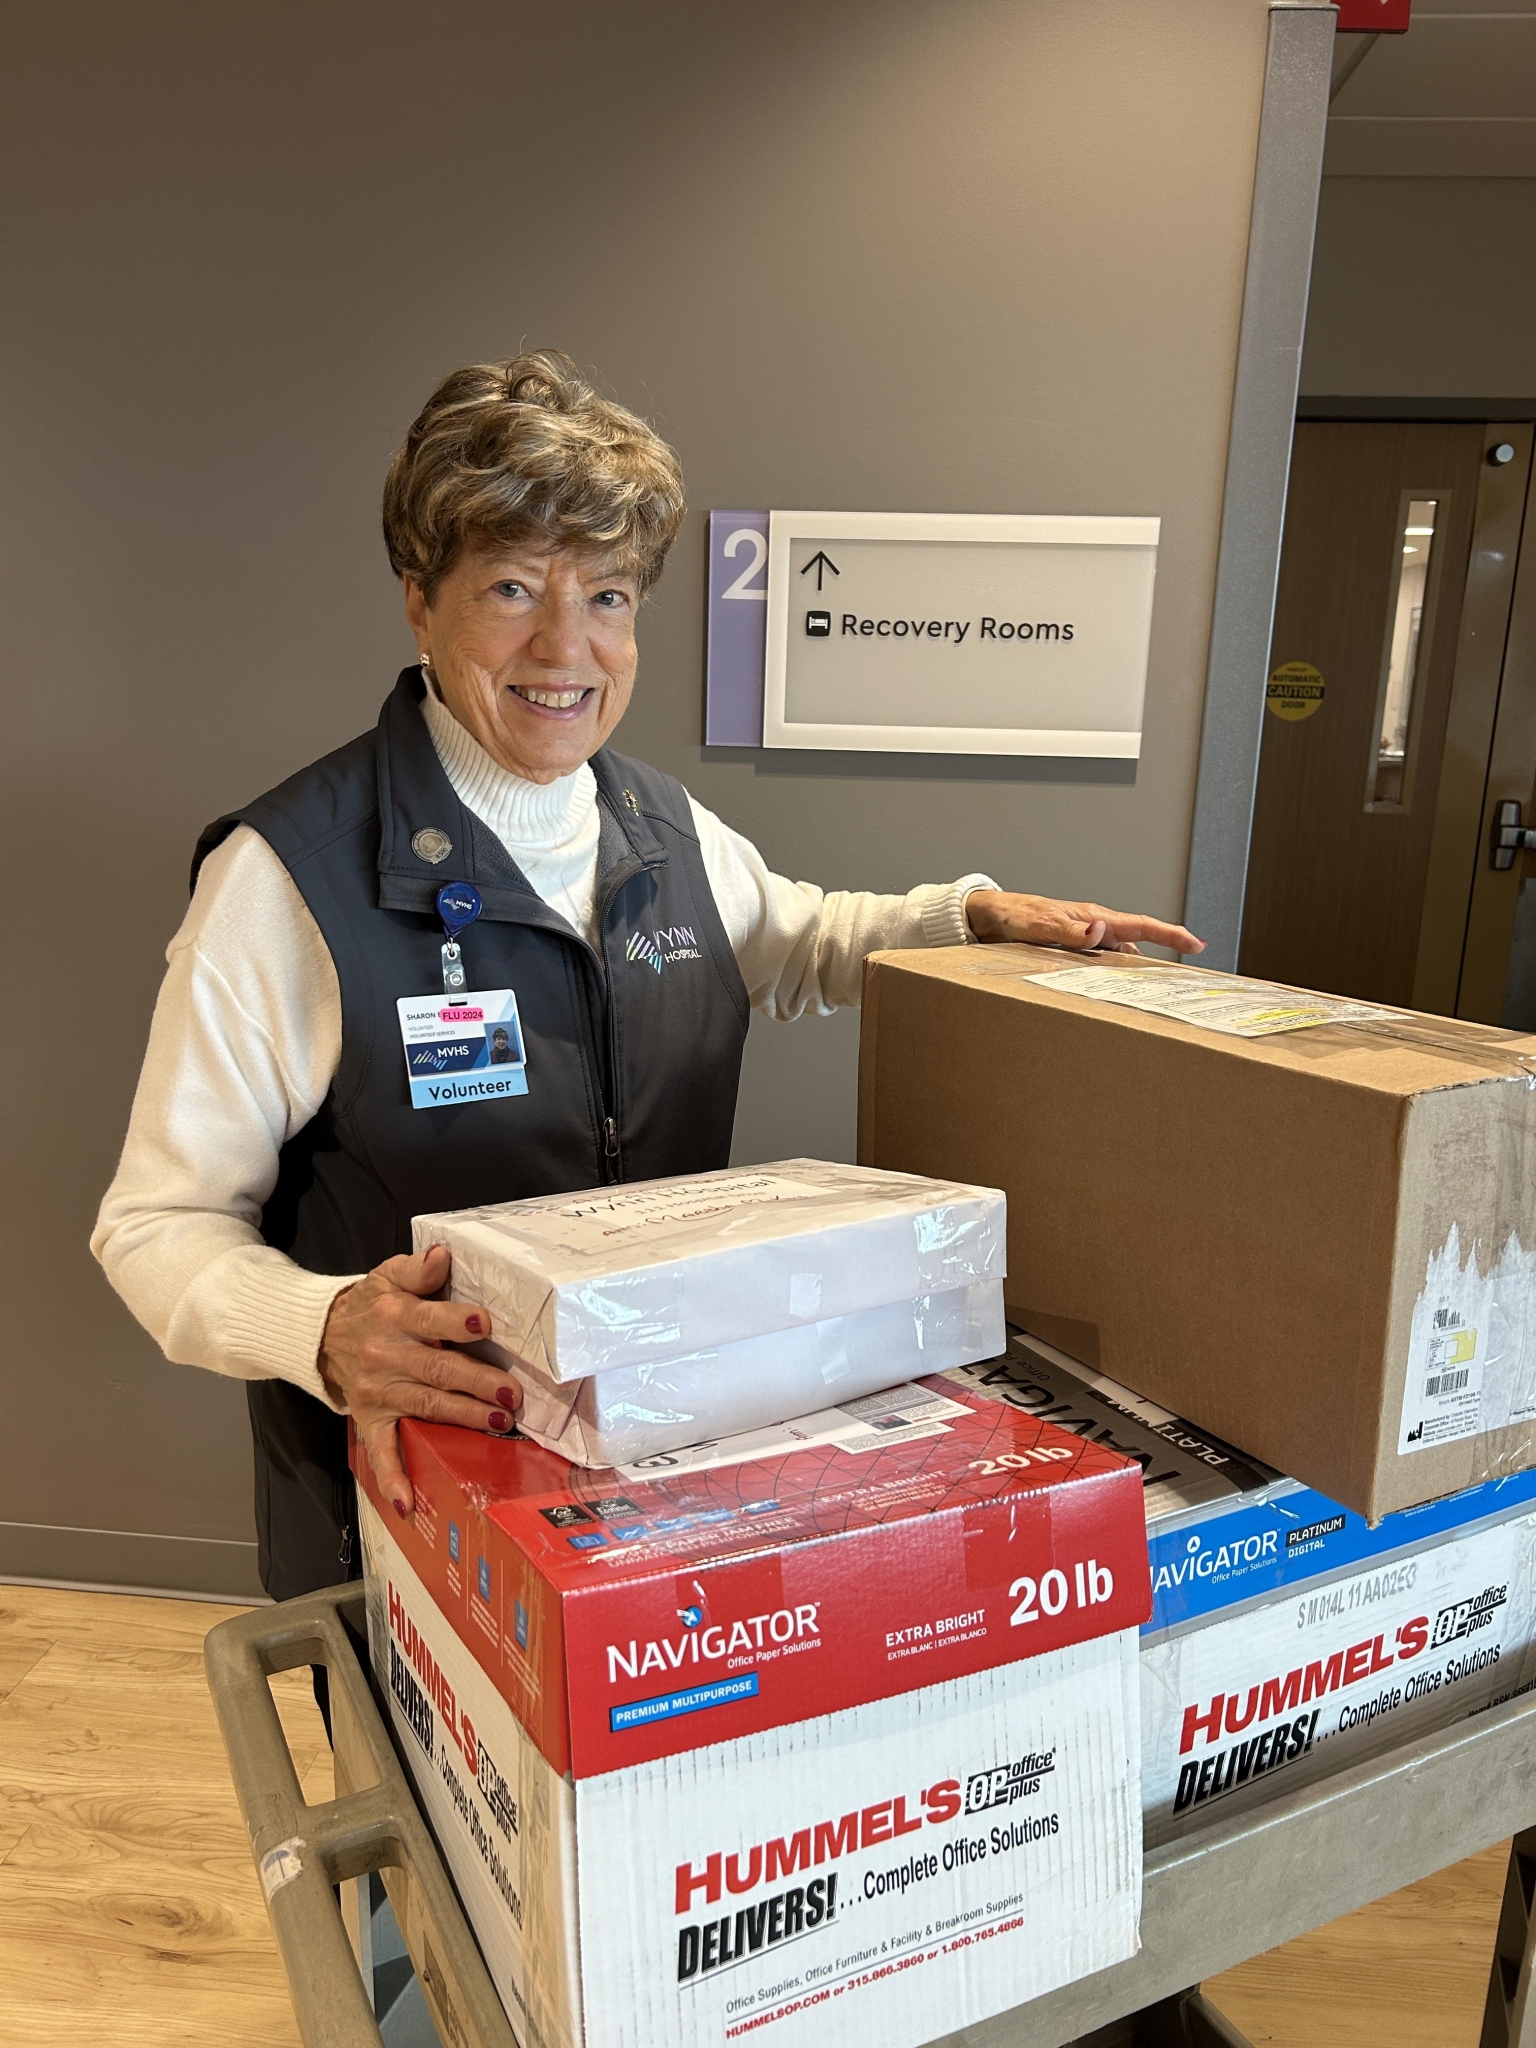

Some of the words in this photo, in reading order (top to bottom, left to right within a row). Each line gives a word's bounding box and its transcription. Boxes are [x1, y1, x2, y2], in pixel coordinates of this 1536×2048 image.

[721, 528, 768, 600] 2
[842, 614, 970, 643] Recovery
[980, 616, 1075, 641] Rooms
[1267, 685, 1320, 698] CAUTION
[406, 1012, 436, 1021] SHARON
[408, 1024, 434, 1032] VOLUNTEER
[442, 1011, 461, 1020] FLU
[462, 1010, 484, 1020] 2024
[409, 1031, 436, 1039] VOLUNTEER
[437, 1045, 470, 1058] MVHS
[428, 1080, 512, 1101] Volunteer
[657, 1178, 777, 1199] Hospital
[1017, 1359, 1050, 1381] Office
[821, 1483, 883, 1504] EXTRA
[883, 1469, 947, 1490] BRIGHT
[702, 1521, 805, 1547] PERFORMANCE
[721, 1526, 756, 1537] JAM
[756, 1516, 795, 1529] FREE
[1288, 1516, 1343, 1545] PLATINUM
[1288, 1539, 1326, 1559] DIGITAL
[1211, 1571, 1230, 1584] Office
[1231, 1565, 1249, 1579] Paper
[1249, 1556, 1278, 1572] Solutions
[1473, 1584, 1508, 1610] office
[885, 1623, 933, 1648] EXTRA
[936, 1609, 985, 1634] BRIGHT
[1466, 1611, 1494, 1638] plus
[606, 1603, 821, 1684] NAVIGATOR
[727, 1654, 754, 1670] Office
[756, 1648, 781, 1663] Paper
[782, 1637, 822, 1656] Solutions
[887, 1647, 911, 1661] EXTRA
[911, 1641, 934, 1656] BLANC
[938, 1635, 961, 1649] EXTRA
[960, 1627, 987, 1643] BLANCO
[388, 1579, 477, 1776] HUMMEL'S
[1178, 1615, 1430, 1756] HUMMEL'S
[616, 1697, 669, 1724] PREMIUM
[672, 1679, 753, 1710] MULTIPURPOSE
[1173, 1708, 1322, 1816] DELIVERS!
[1404, 1670, 1442, 1703] Office
[1445, 1643, 1501, 1686] Solutions
[1011, 1751, 1053, 1777] office
[391, 1637, 434, 1760] DELIVERS!
[469, 1797, 488, 1864] Office
[489, 1835, 523, 1931] Solutions
[496, 1773, 518, 1824] office
[1008, 1777, 1041, 1806] plus
[496, 1801, 512, 1844] plus
[674, 1777, 962, 1915] HUMMEL'S
[677, 1872, 840, 1984] DELIVERS!
[942, 1834, 988, 1872] Office
[990, 1812, 1060, 1855] Solutions
[725, 1992, 756, 2014] Office
[758, 1975, 803, 2001] Supplies,
[805, 1960, 834, 1983] Office
[836, 1945, 879, 1971] Furniture
[881, 1940, 889, 1952] &
[890, 1928, 923, 1949] Facility
[925, 1924, 933, 1936] &
[935, 1908, 984, 1933] Breakroom
[986, 1893, 1024, 1914] Supplies
[725, 1989, 831, 2040] HUMMELSOP.COM
[833, 1985, 845, 1997] or
[927, 1950, 939, 1961] or
